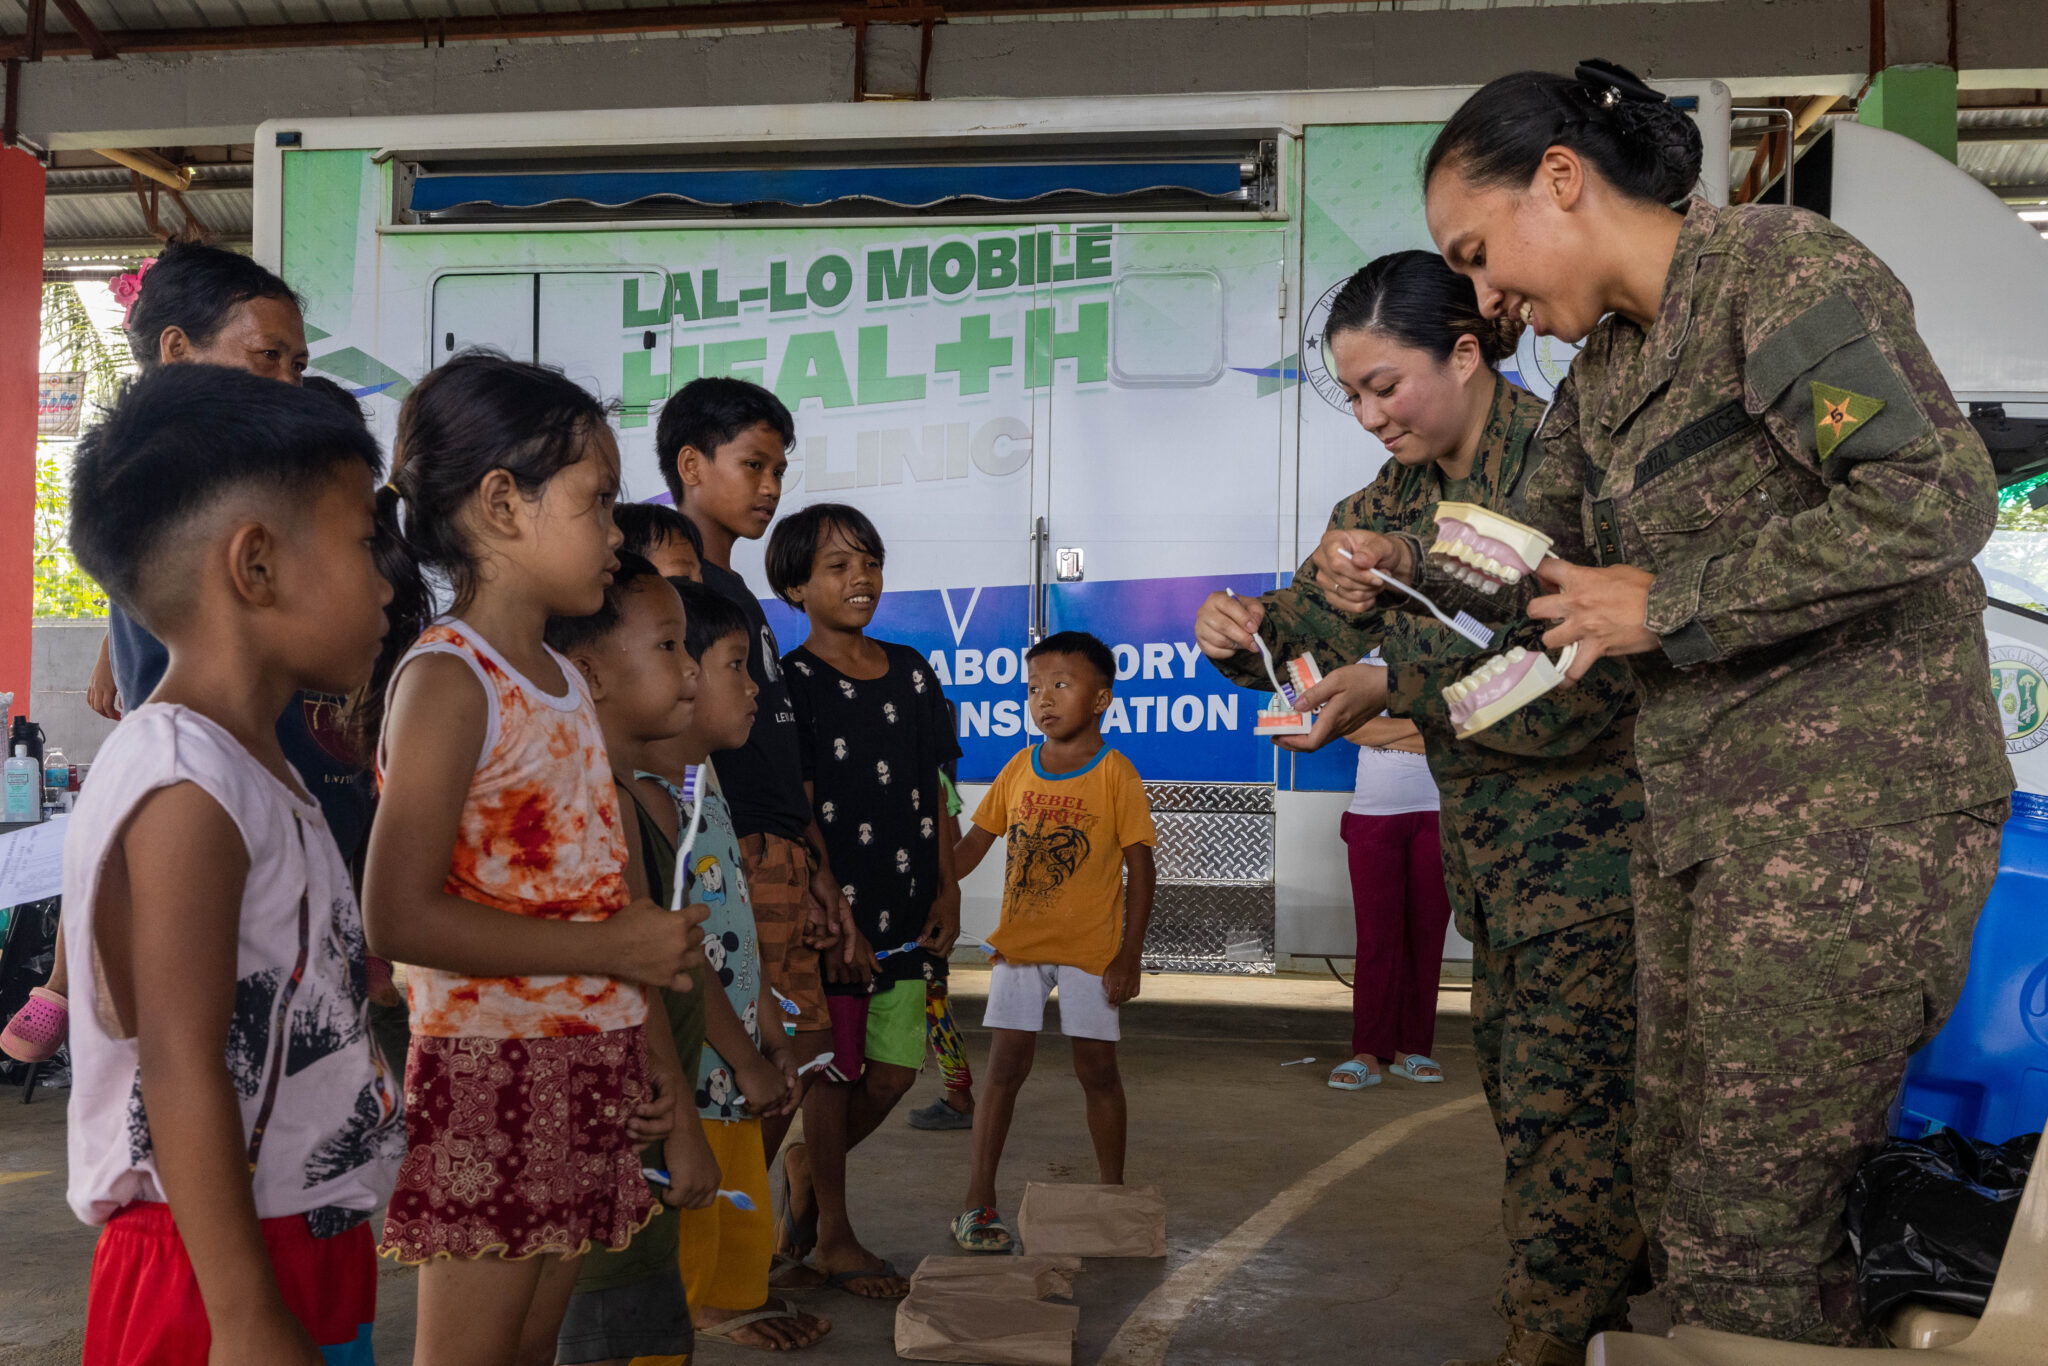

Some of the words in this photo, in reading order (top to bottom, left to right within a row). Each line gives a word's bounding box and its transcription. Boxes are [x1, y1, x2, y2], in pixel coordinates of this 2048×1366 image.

[623, 254, 853, 328] LAL-LO
[867, 224, 1113, 302] MOBILE
[1309, 366, 1353, 413] LALAWIG
[1675, 409, 1744, 455] SERVICE
[1830, 407, 1844, 424] 5
[928, 642, 1201, 686] ABOORY
[960, 693, 1239, 738] NSATION
[1018, 806, 1087, 826] SPIRIT
[1021, 791, 1088, 811] REBEL
